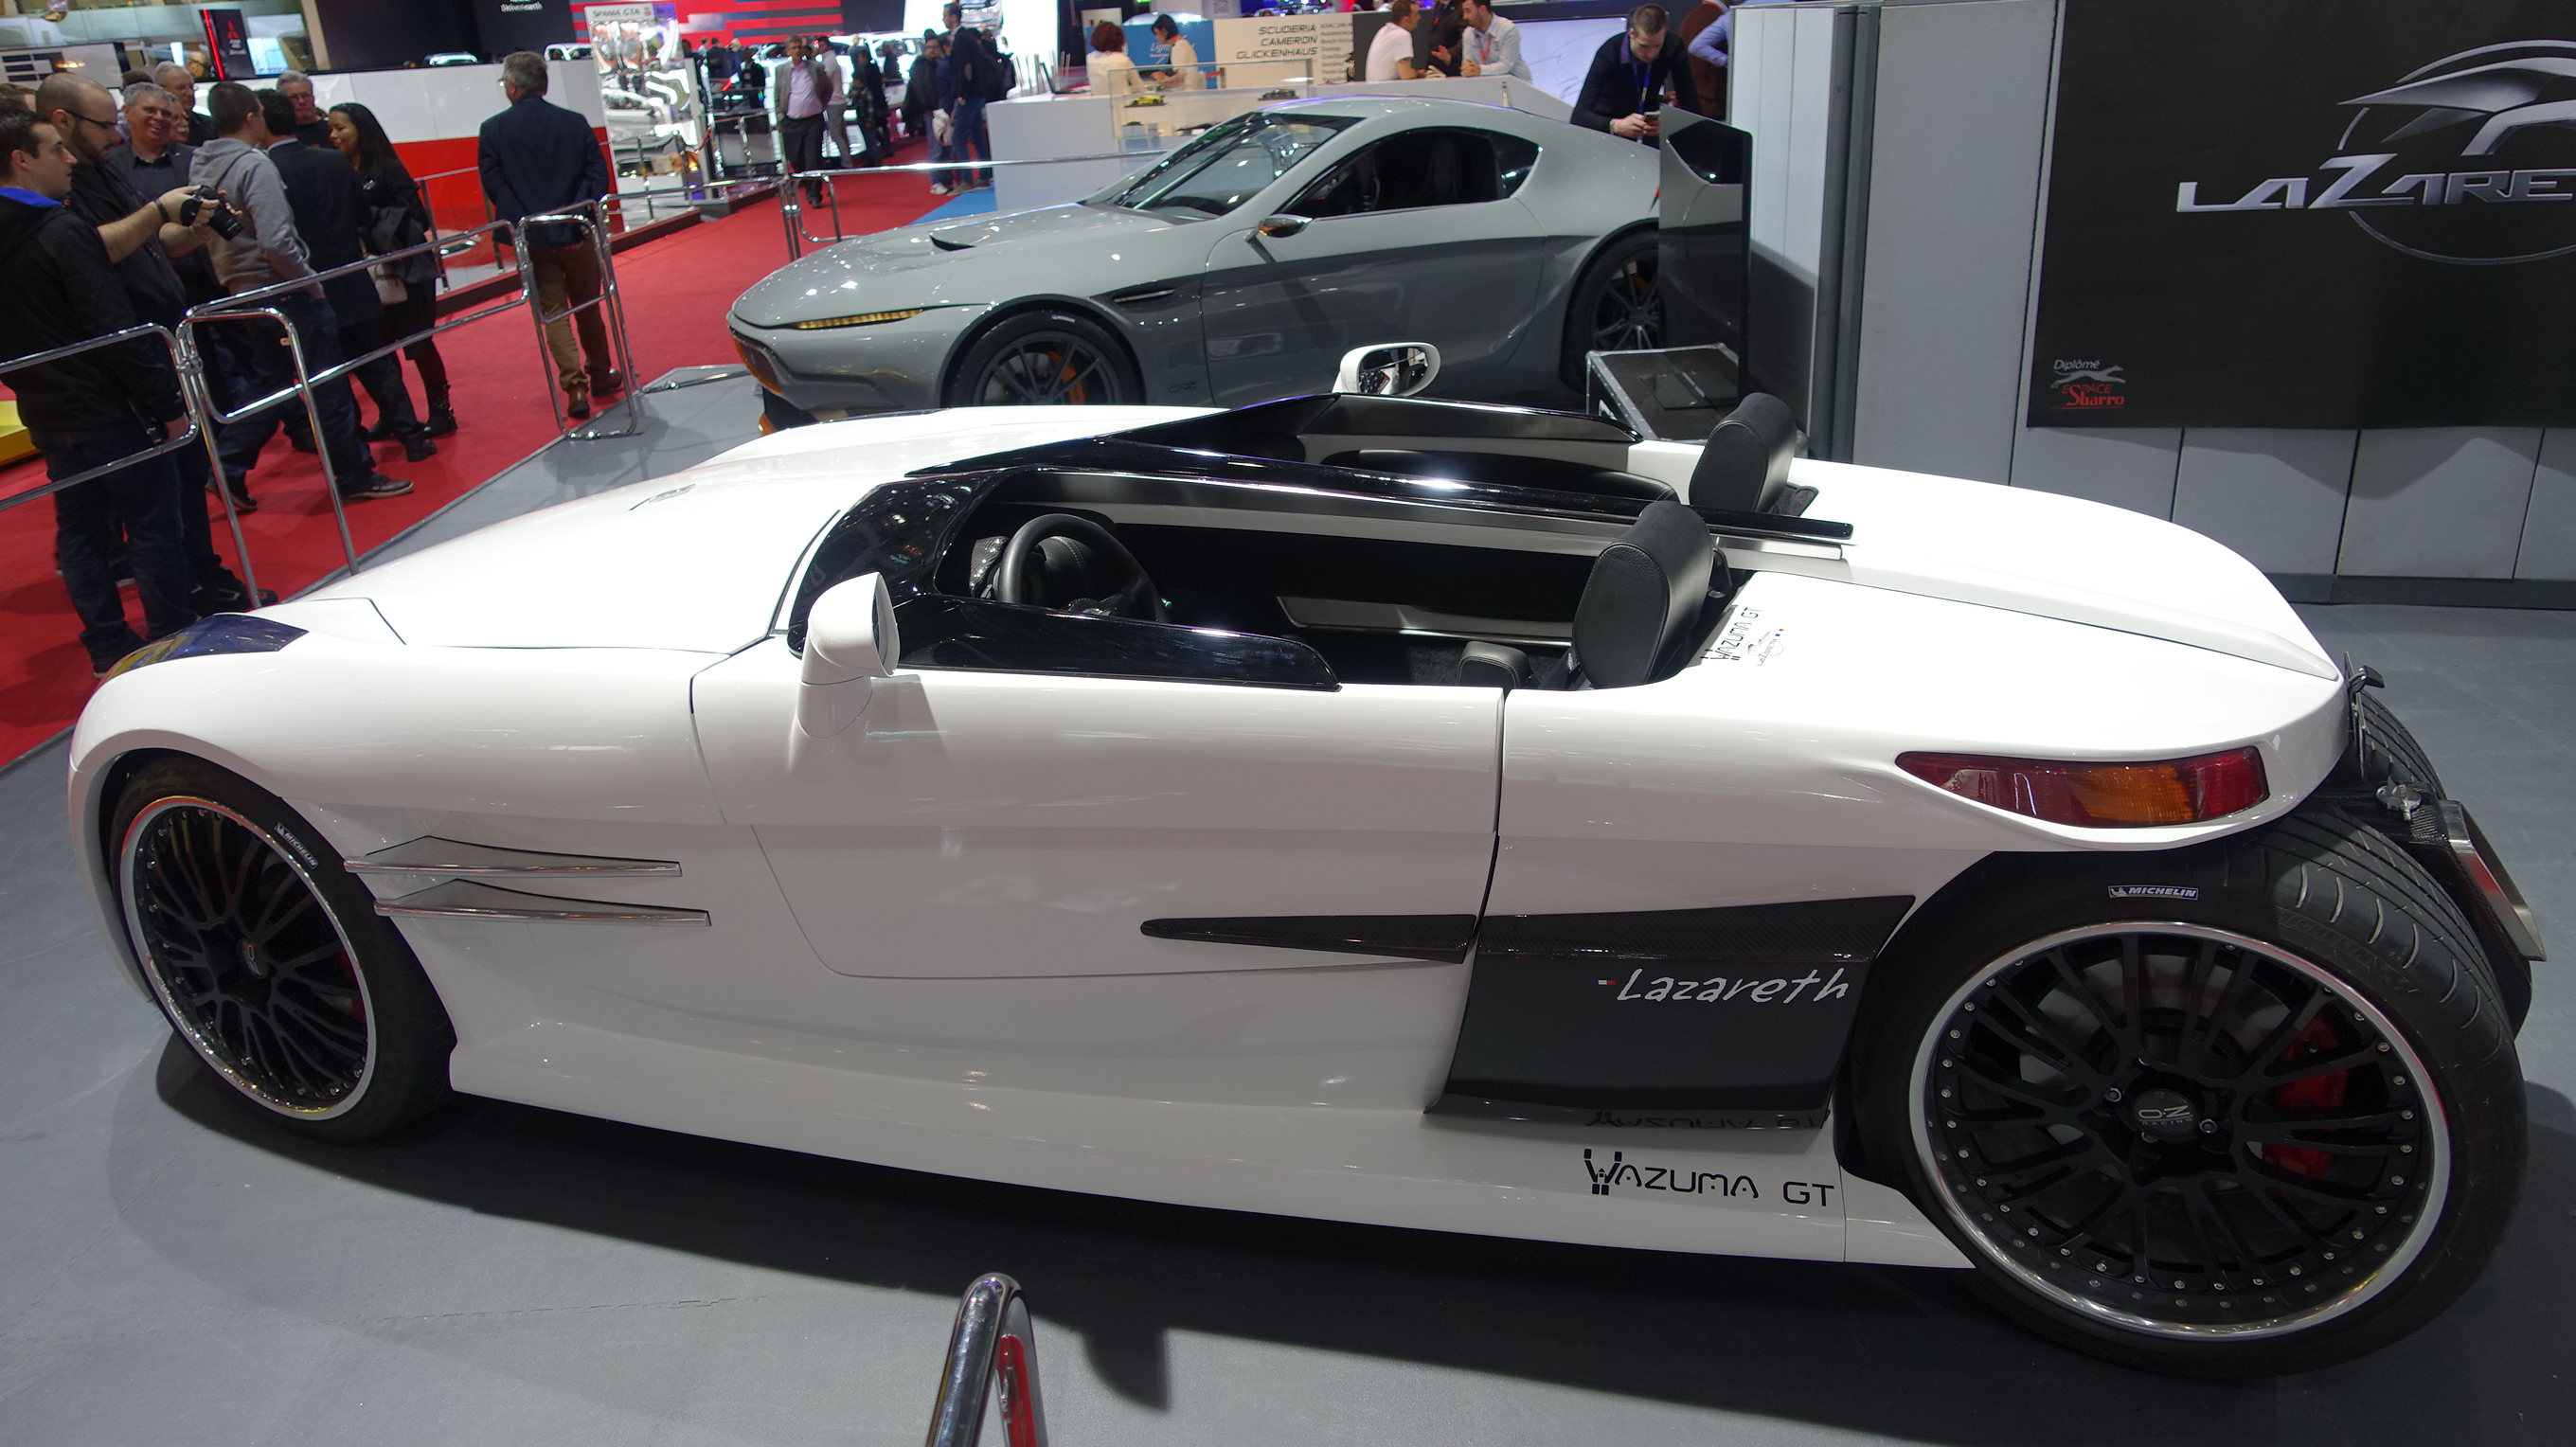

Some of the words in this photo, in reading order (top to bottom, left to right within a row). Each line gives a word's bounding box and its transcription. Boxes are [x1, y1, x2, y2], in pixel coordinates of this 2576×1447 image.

[1259, 24, 1317, 35] SCUDERIA
[1261, 36, 1318, 46] CAMERON
[1236, 46, 1318, 60] GLICKENHAUS
[2053, 359, 2102, 371] Diplômé
[2066, 384, 2125, 406] Sbarro
[1741, 607, 1762, 619] GT
[284, 832, 317, 866] MICHELIN
[2128, 886, 2197, 898] MICHELIN
[1617, 967, 1850, 1004] Lazareth
[1583, 1148, 1760, 1197] WAZUMA
[1782, 1181, 1835, 1206] GT
